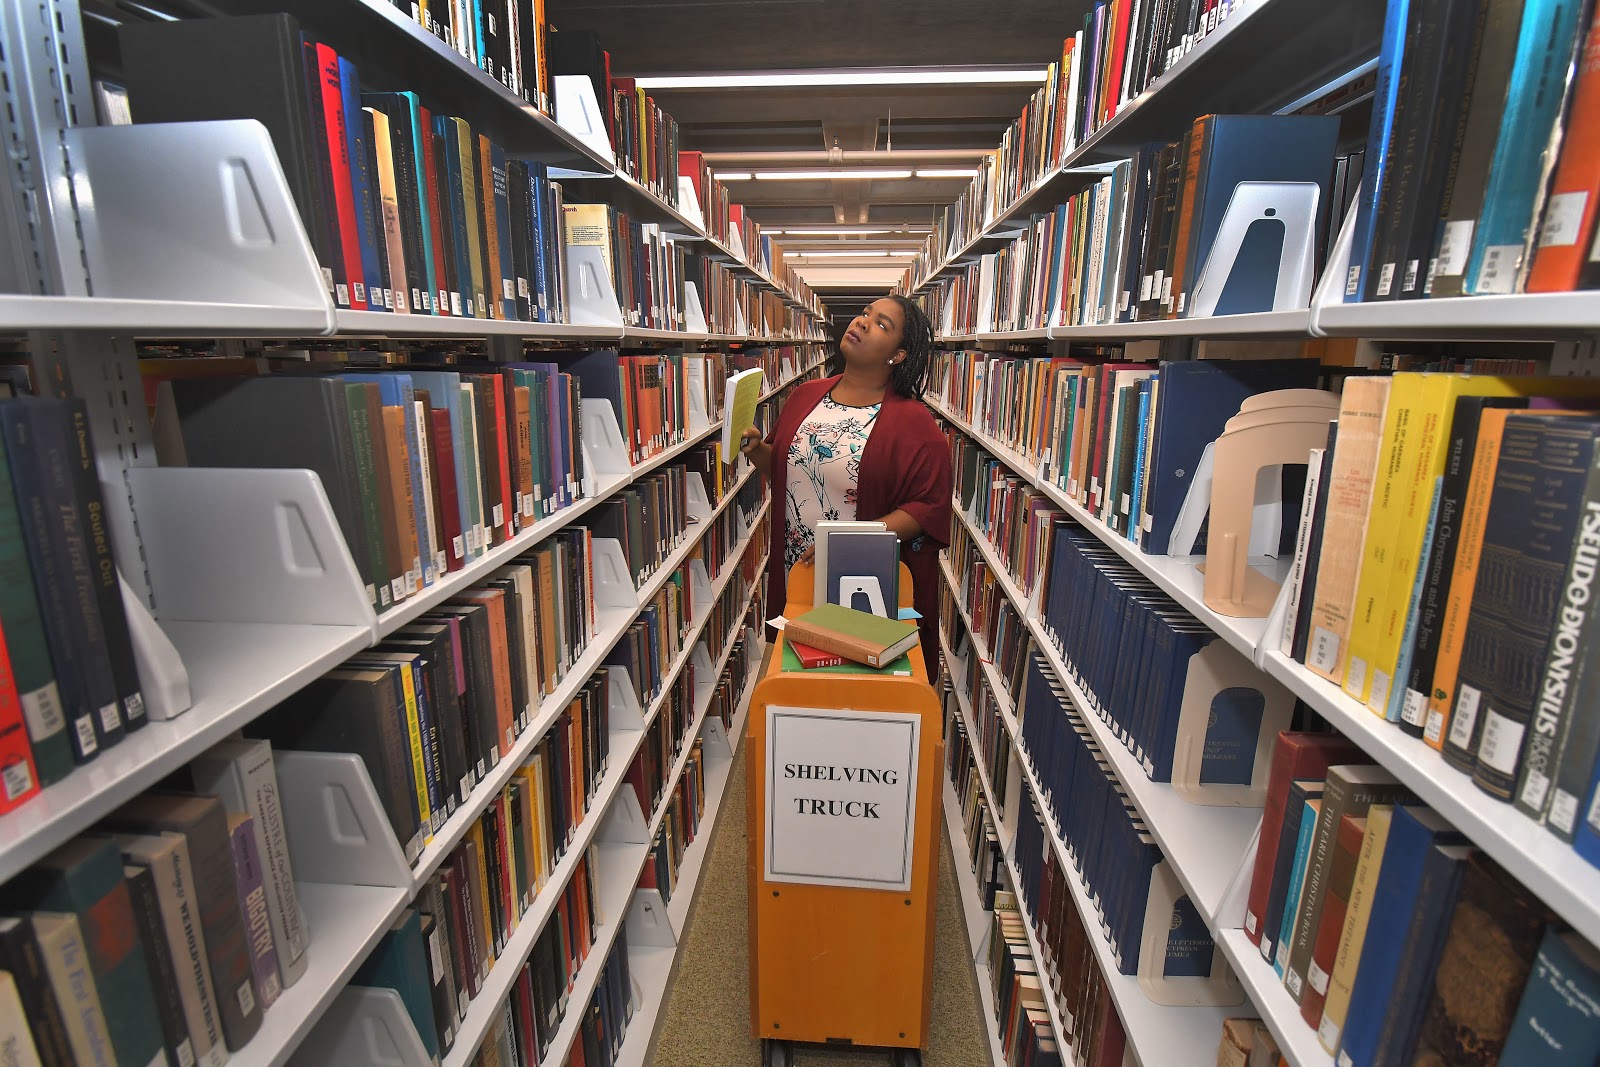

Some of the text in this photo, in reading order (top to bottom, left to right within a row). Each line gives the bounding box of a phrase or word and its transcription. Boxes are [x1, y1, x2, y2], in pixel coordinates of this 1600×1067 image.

[1394, 408, 1403, 444] CHRISTIAN,
[1401, 428, 1406, 438] OF
[1428, 434, 1433, 444] OF
[1387, 445, 1396, 481] HUMANIST,
[1395, 439, 1403, 473] CAESAREA
[1422, 445, 1431, 480] CAESAREA
[1450, 436, 1464, 475] WILKEN
[58, 502, 77, 534] The
[1408, 489, 1417, 518] ASCETIC
[87, 499, 115, 587] Souled Out
[1419, 495, 1455, 650] John Chrysostom and the Jews
[429, 726, 441, 781] En la Lucha
[784, 763, 898, 785] SHELVING
[263, 782, 274, 804] The
[794, 798, 880, 819] TRUCK
[267, 802, 284, 849] LUSTRE
[274, 849, 281, 859] of
[1365, 829, 1374, 859] AFTER
[1300, 806, 1333, 949] THE EARLY CHRISTIAN BOOK
[180, 901, 191, 924] WE
[280, 870, 297, 932] COUNTRY
[246, 886, 274, 959] BIGOTRY
[59, 936, 80, 968] The
[185, 924, 199, 962] HOLD
[1341, 915, 1355, 968] TESTAMENT
